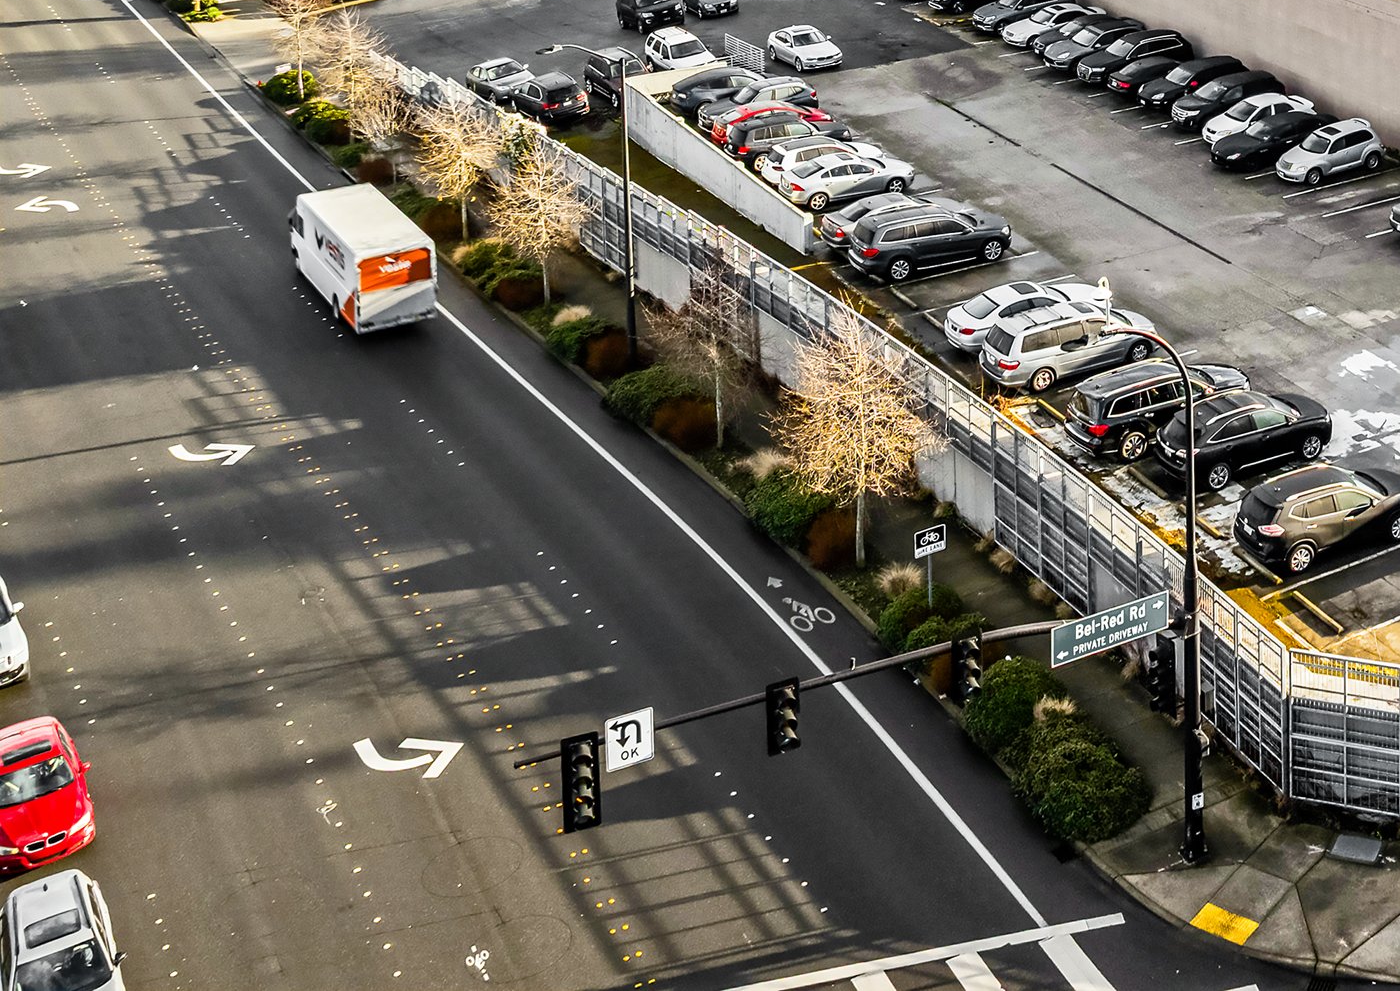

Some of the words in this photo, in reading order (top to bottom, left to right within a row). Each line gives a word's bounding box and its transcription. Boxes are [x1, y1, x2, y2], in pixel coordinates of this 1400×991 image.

[1072, 635, 1106, 656] PRIVATE
[1108, 621, 1149, 643] DRIVEWAY
[1075, 609, 1124, 640] Bel-Red
[1129, 602, 1146, 622] Rd
[620, 747, 639, 761] OK
